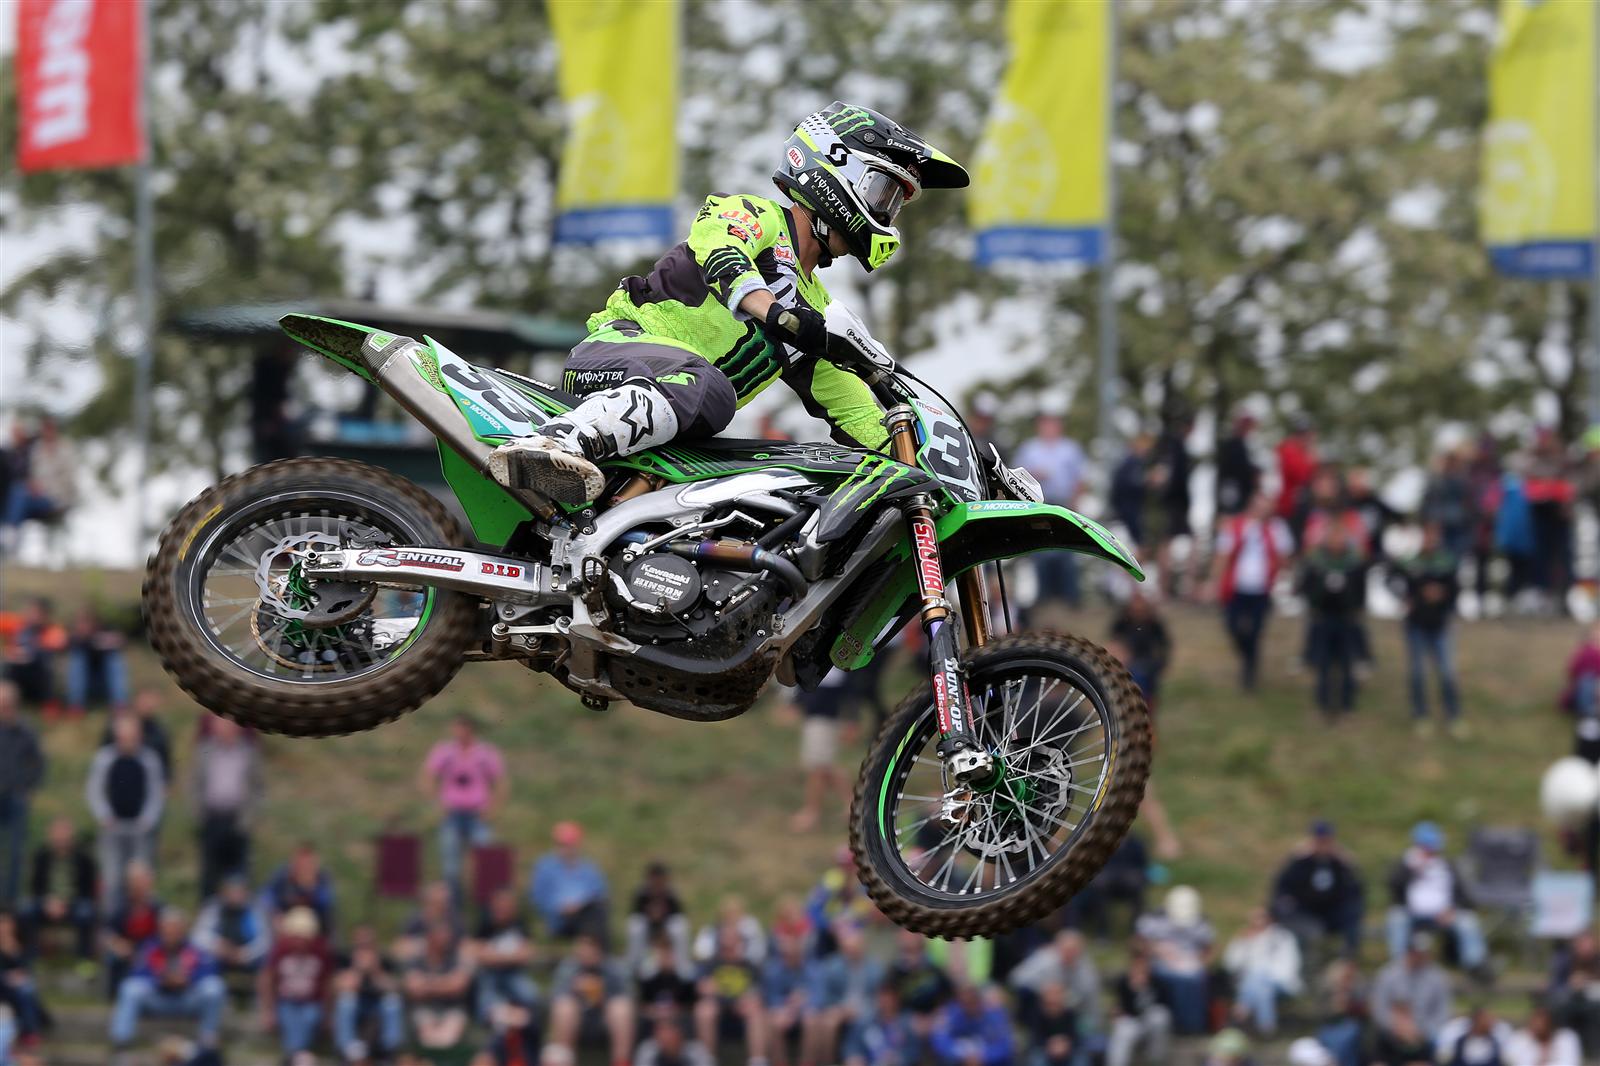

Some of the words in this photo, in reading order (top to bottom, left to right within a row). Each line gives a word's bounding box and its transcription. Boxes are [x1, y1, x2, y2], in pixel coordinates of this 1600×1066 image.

[788, 148, 802, 169] BELL
[893, 141, 922, 154] SCOTT
[811, 171, 852, 222] MONSTER
[811, 184, 839, 218] ENERGY
[846, 328, 878, 360] Polisport
[495, 367, 558, 391] Kawasaki
[576, 371, 624, 384] MONSTER
[469, 404, 504, 431] MOTOREX
[927, 420, 970, 481] 3
[983, 502, 1032, 511] MOTOREX
[358, 549, 466, 567] RENTHAL
[913, 522, 944, 592] SHOWA
[640, 563, 691, 585] Kawasaki
[644, 572, 665, 582] Racing
[665, 578, 682, 587] Team
[633, 577, 684, 597] HINSON
[933, 673, 947, 732] Polisport
